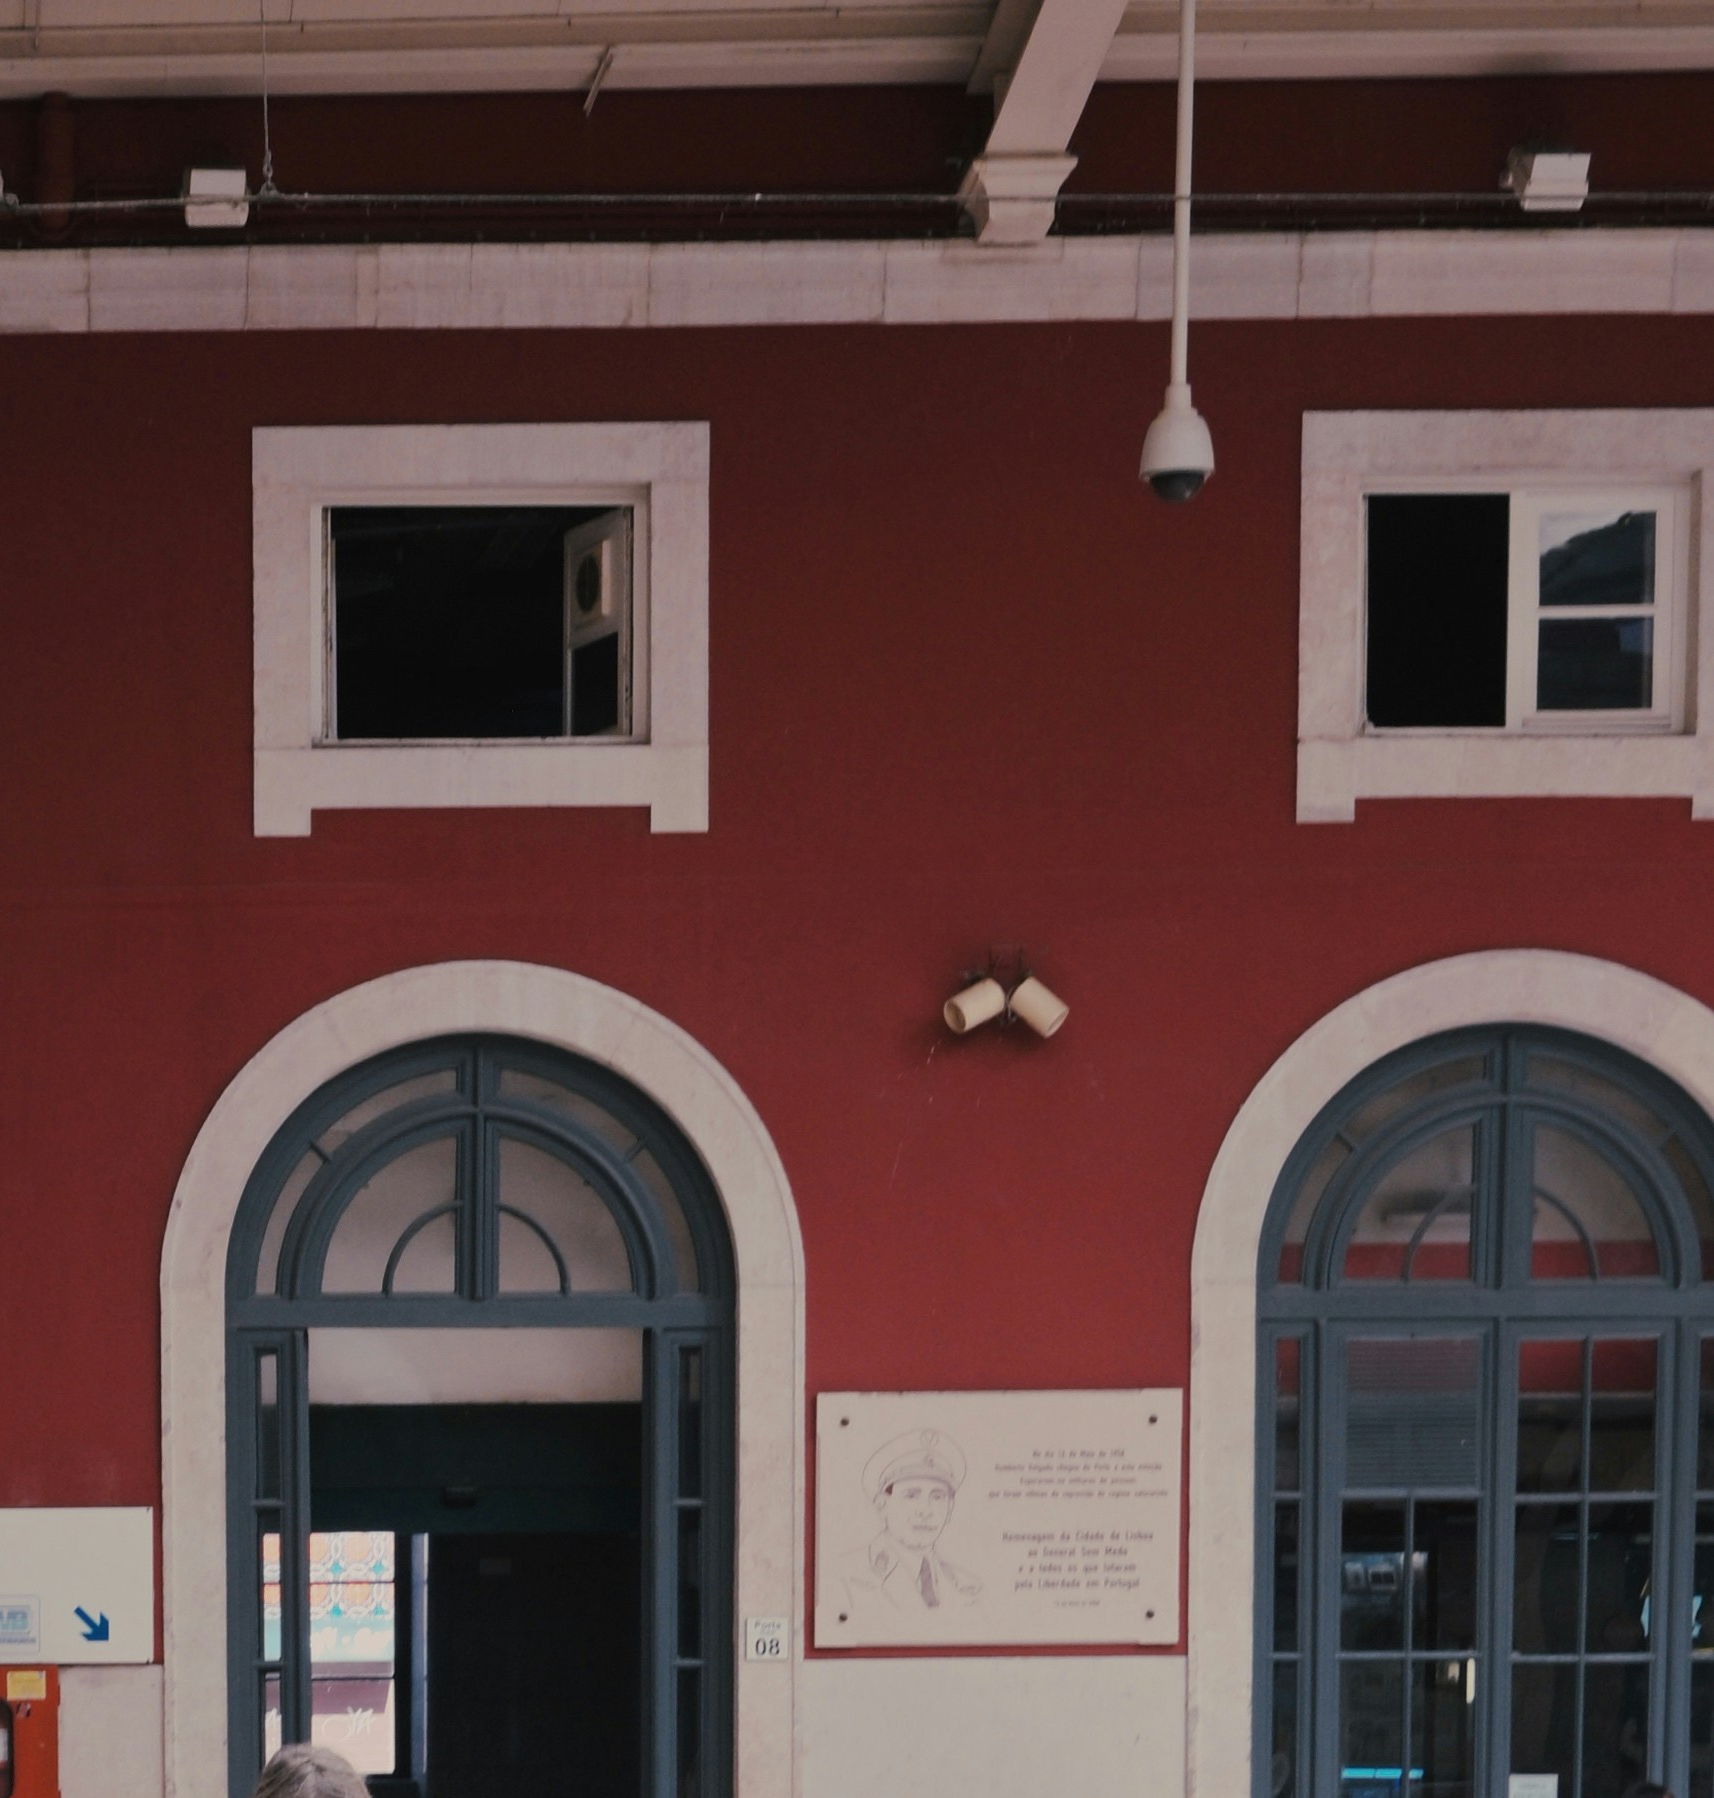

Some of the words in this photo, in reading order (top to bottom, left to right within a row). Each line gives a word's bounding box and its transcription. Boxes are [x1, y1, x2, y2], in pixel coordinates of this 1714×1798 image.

[1002, 1532, 1055, 1543] Homenagem
[1075, 1531, 1104, 1541] Cidade
[1125, 1531, 1153, 1540] Lisboa
[1043, 1547, 1076, 1557] General
[1105, 1546, 1128, 1556] Medo
[1039, 1563, 1062, 1573] todos
[1038, 1578, 1080, 1589] Liberdade
[1104, 1578, 1140, 1592] Portugal
[755, 1638, 780, 1656] 08
